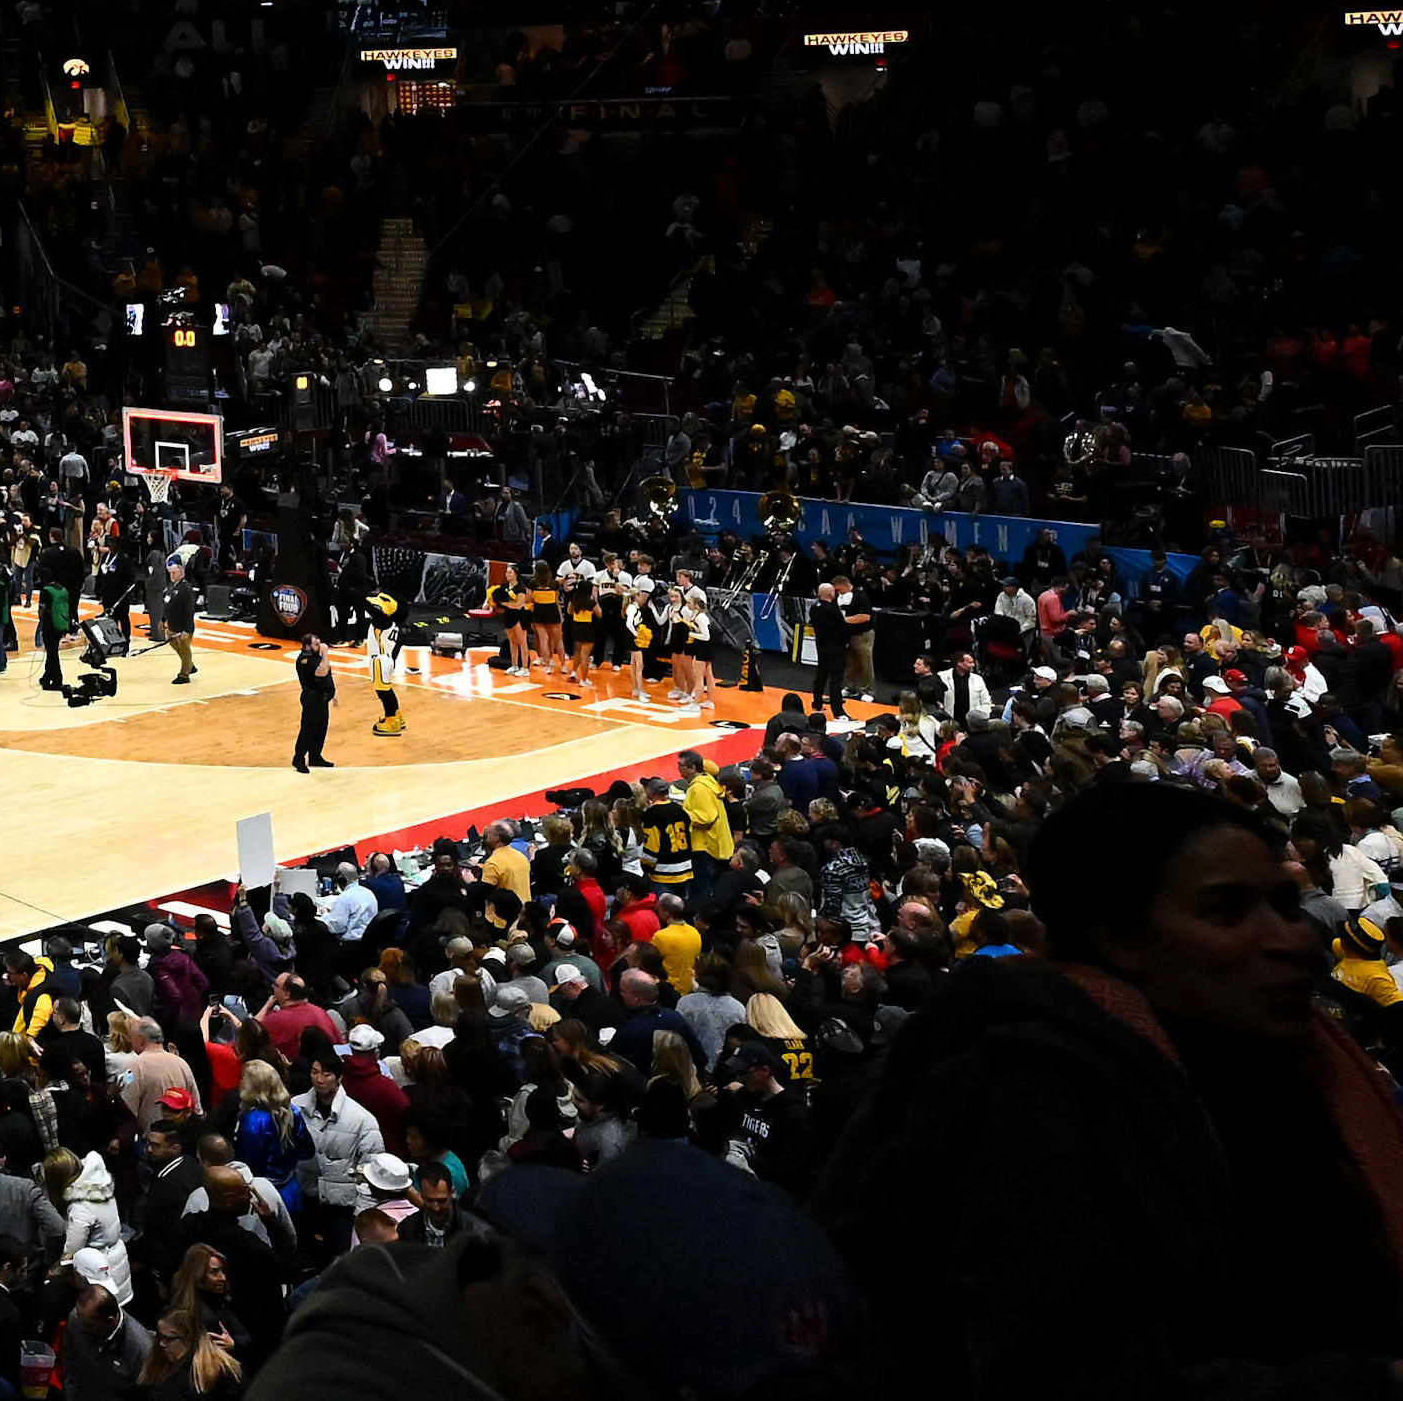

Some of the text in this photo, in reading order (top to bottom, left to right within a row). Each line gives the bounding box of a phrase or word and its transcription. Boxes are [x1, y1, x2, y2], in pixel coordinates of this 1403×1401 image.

[807, 32, 908, 45] HAWKEYES
[363, 49, 456, 61] HAWKEYES
[828, 42, 885, 56] WIN!!!
[383, 58, 435, 70] WIN!!!
[173, 331, 195, 347] 0.0
[280, 593, 298, 604] FINAL
[279, 602, 299, 614] FOUR
[665, 821, 689, 854] 16
[781, 1052, 814, 1080] 22
[742, 1113, 771, 1139] TIGERS
